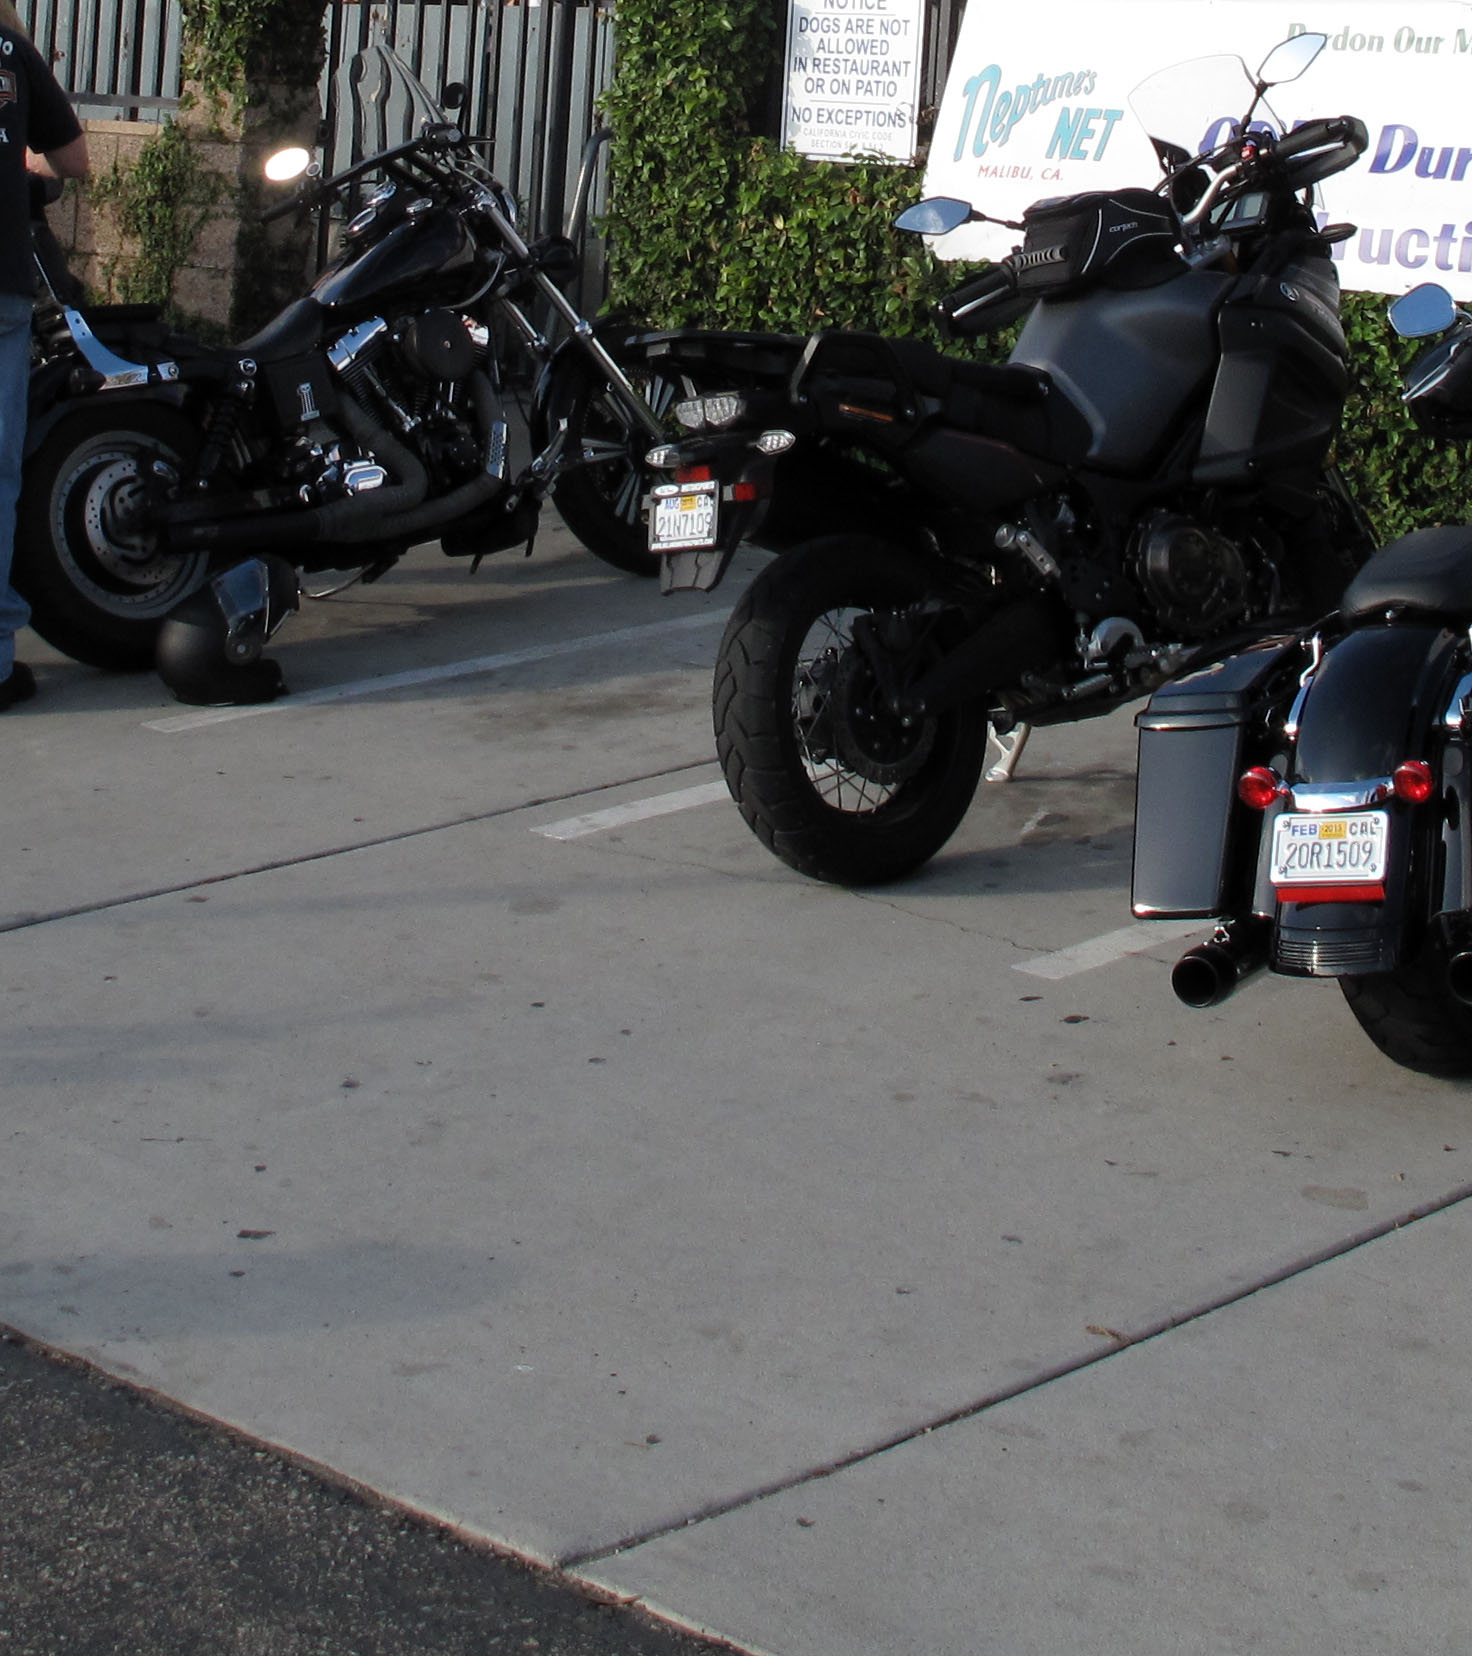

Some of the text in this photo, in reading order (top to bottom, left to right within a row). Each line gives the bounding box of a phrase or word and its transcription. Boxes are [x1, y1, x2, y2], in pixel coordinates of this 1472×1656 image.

[799, 16, 910, 36] DOGS ARE NOT
[816, 38, 890, 56] ALLOWED
[1393, 25, 1444, 55] Our
[793, 56, 911, 77] IN RESTAURANT
[804, 77, 898, 98] OR ON PATIO
[791, 107, 907, 128] NO EXCEPTIONS
[1045, 106, 1125, 162] NET
[977, 164, 1064, 181] MALIBU, CA.
[1291, 823, 1318, 837] FEB
[1348, 820, 1377, 836] CAL
[1285, 840, 1373, 869] 20R1509
